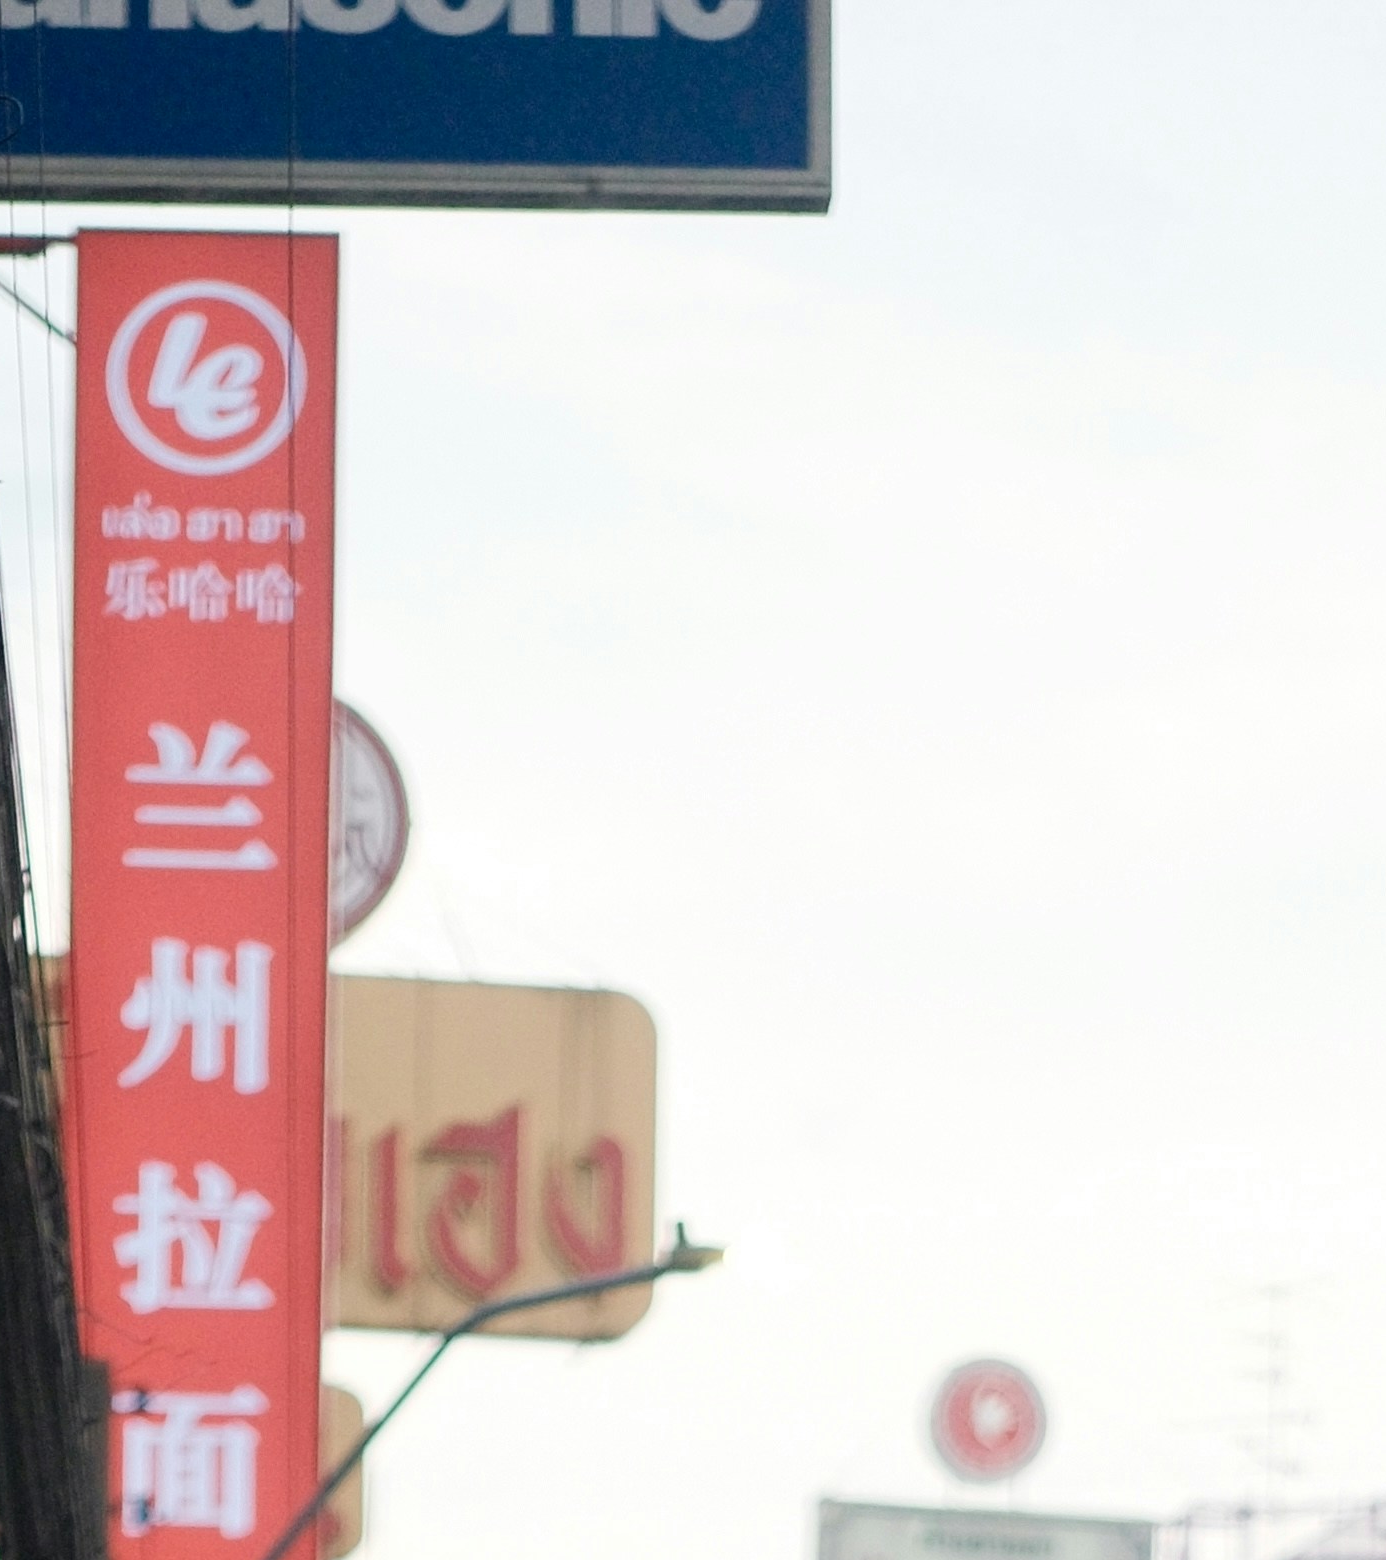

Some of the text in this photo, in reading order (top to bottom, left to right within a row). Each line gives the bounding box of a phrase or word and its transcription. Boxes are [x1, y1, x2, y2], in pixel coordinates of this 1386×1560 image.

[102, 556, 301, 624] 乐哈哈
[113, 722, 279, 1540] 兰州拉面
